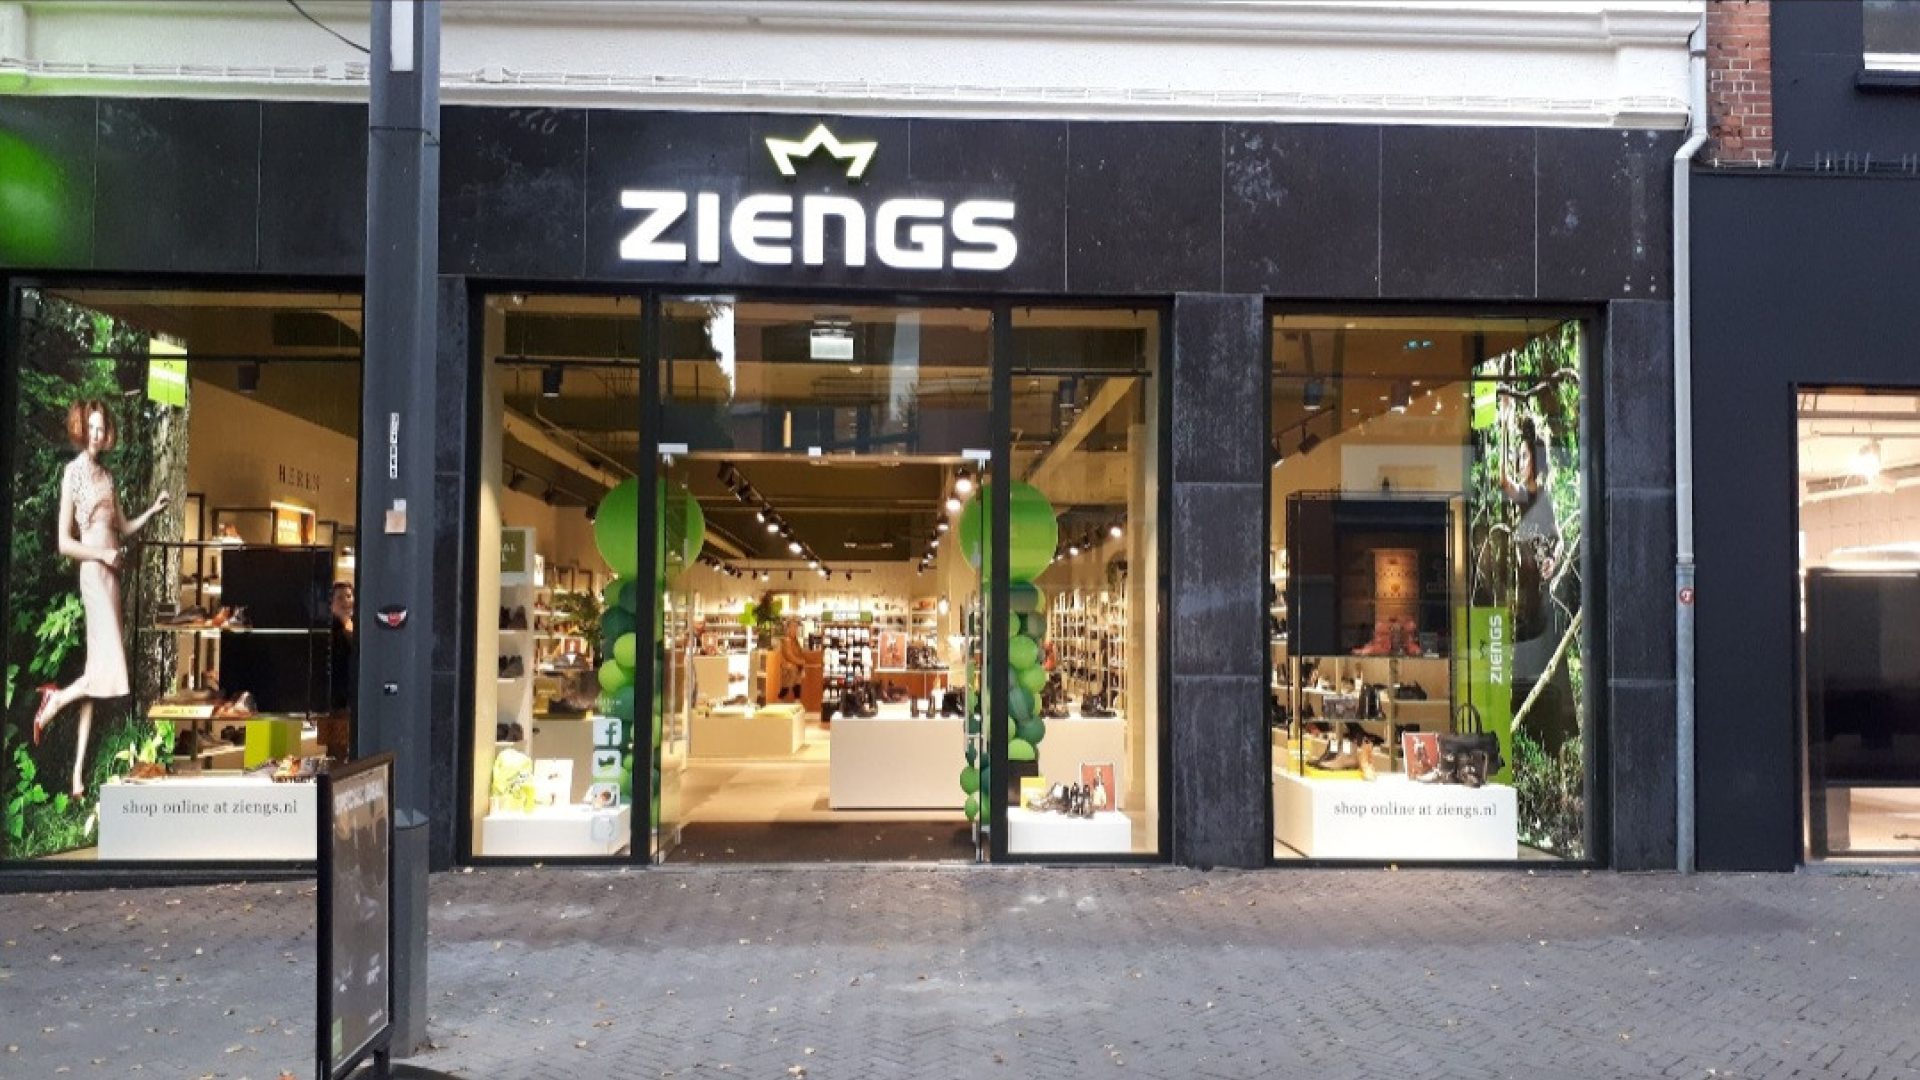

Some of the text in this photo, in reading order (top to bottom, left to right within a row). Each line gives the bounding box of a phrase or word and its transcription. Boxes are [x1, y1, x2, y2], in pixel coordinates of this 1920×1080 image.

[619, 189, 1019, 271] ZIENGS
[1489, 614, 1503, 685] ZIENGS
[121, 799, 298, 817] shop online at ziengs.nl
[1333, 800, 1497, 818] shop online at ziengs.nl
